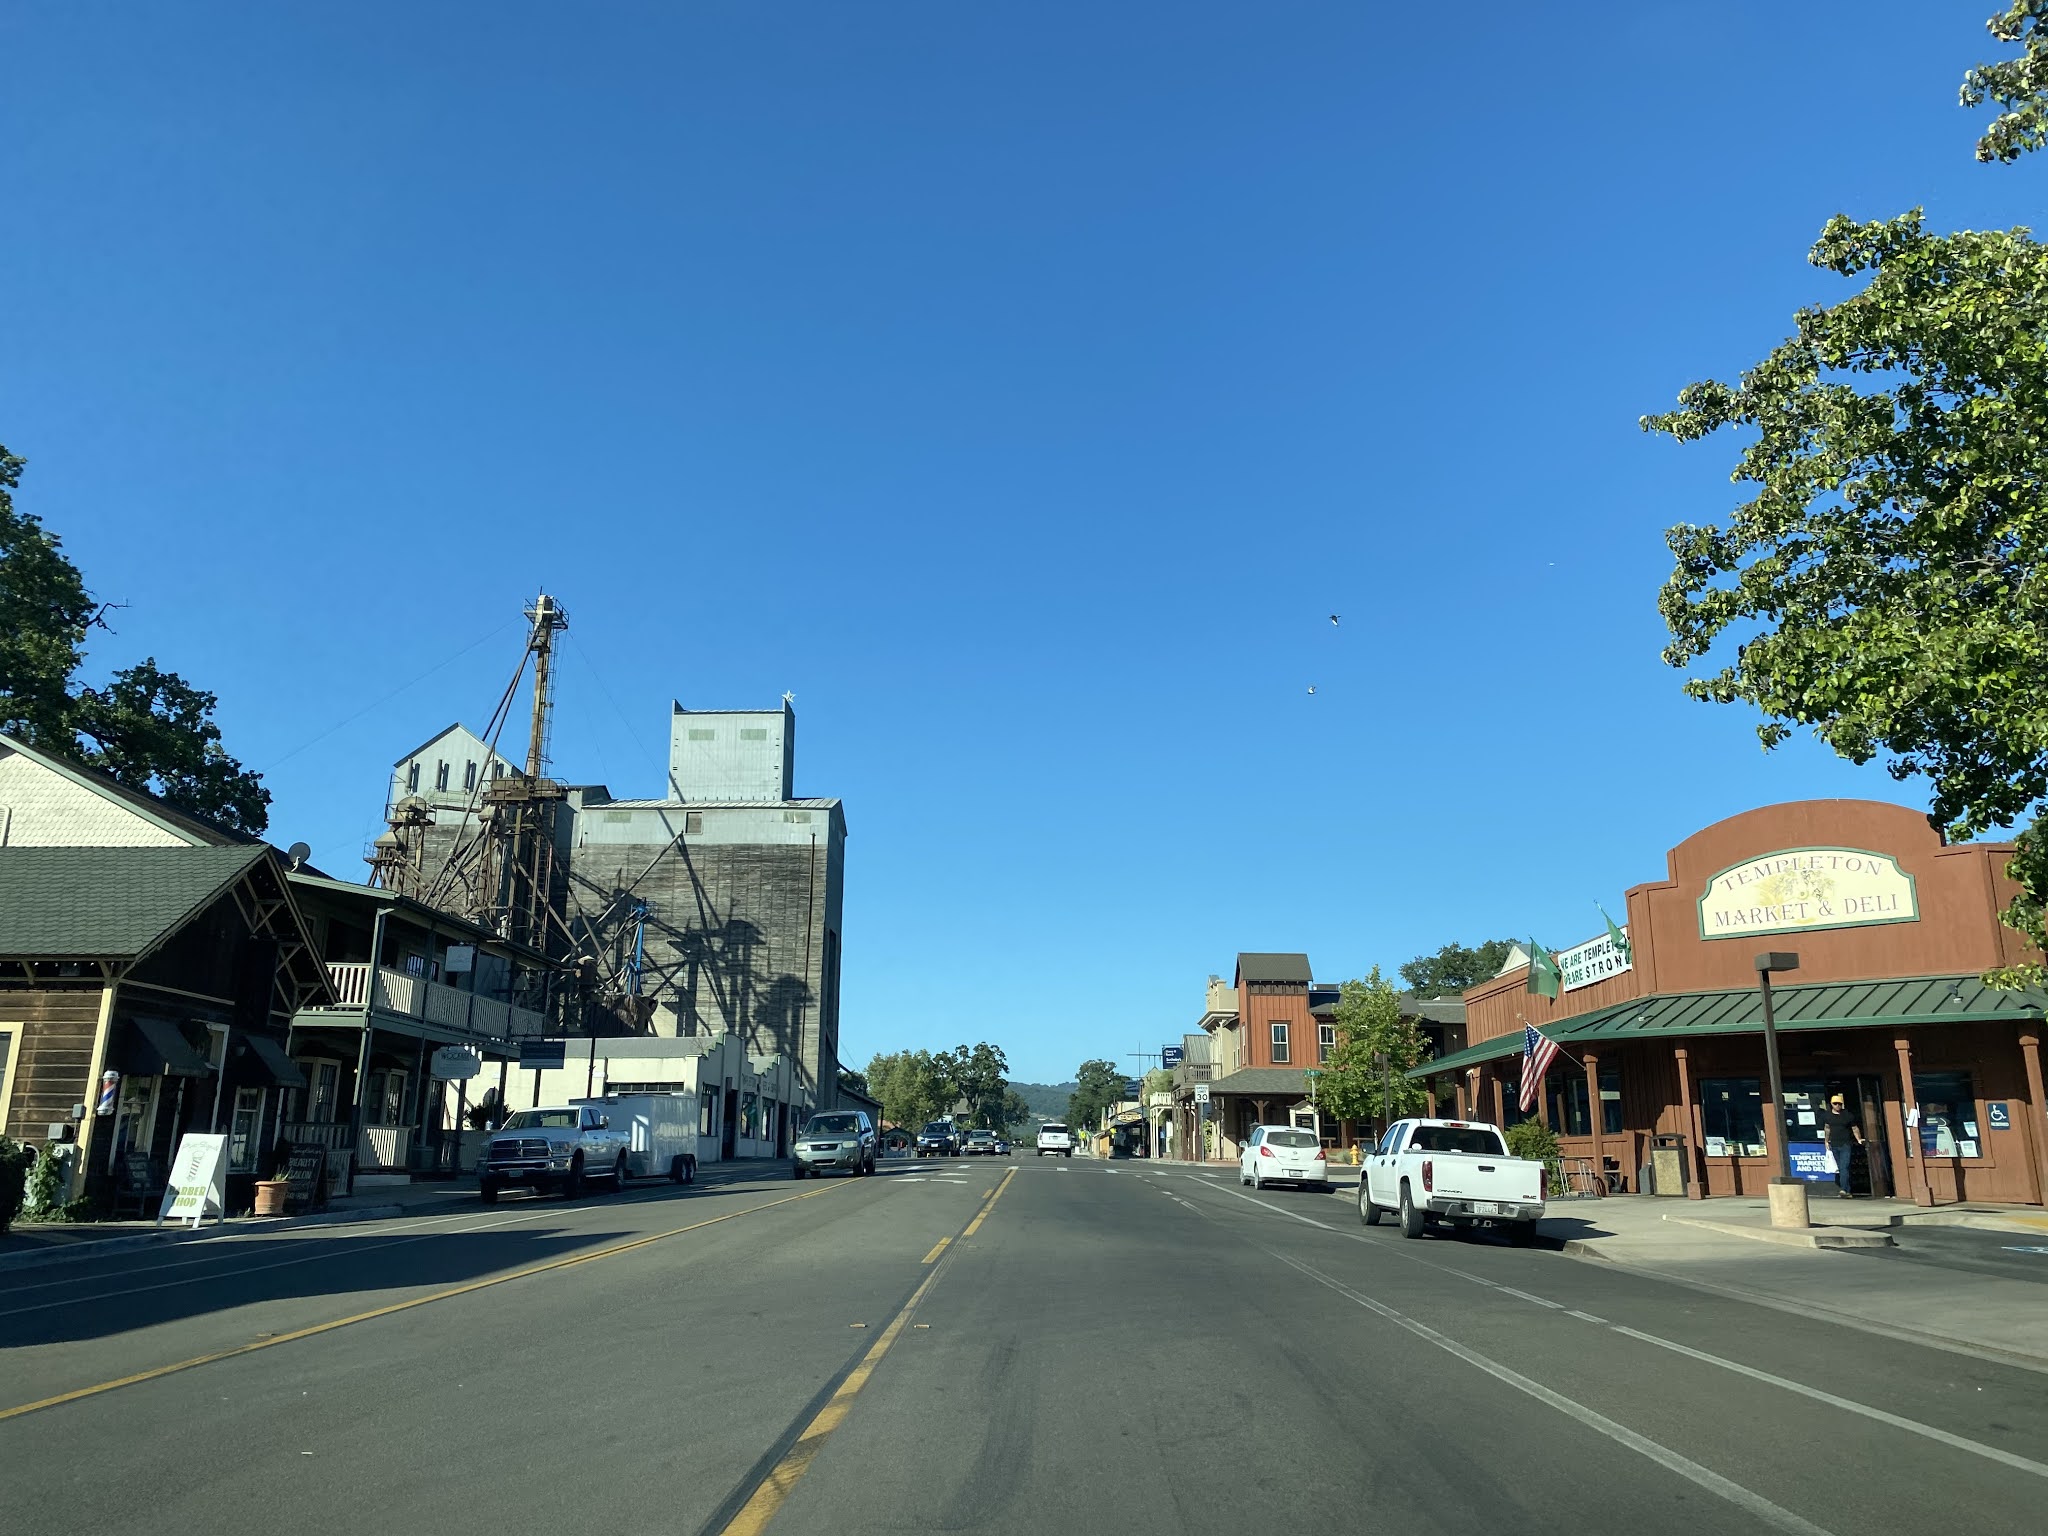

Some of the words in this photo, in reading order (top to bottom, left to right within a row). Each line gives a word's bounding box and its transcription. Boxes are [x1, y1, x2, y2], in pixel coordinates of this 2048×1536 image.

[1719, 855, 1883, 892] TEMPLETON
[1714, 902, 1809, 928] MARKET
[1818, 899, 1836, 917] &
[1844, 893, 1900, 915] DELI
[1570, 952, 1582, 967] ARE
[1583, 938, 1615, 962] TEMPLET
[1572, 968, 1584, 983] ARE
[1197, 1093, 1208, 1101] 30
[288, 1157, 319, 1168] BEAUTY
[167, 1185, 207, 1196] BARBER
